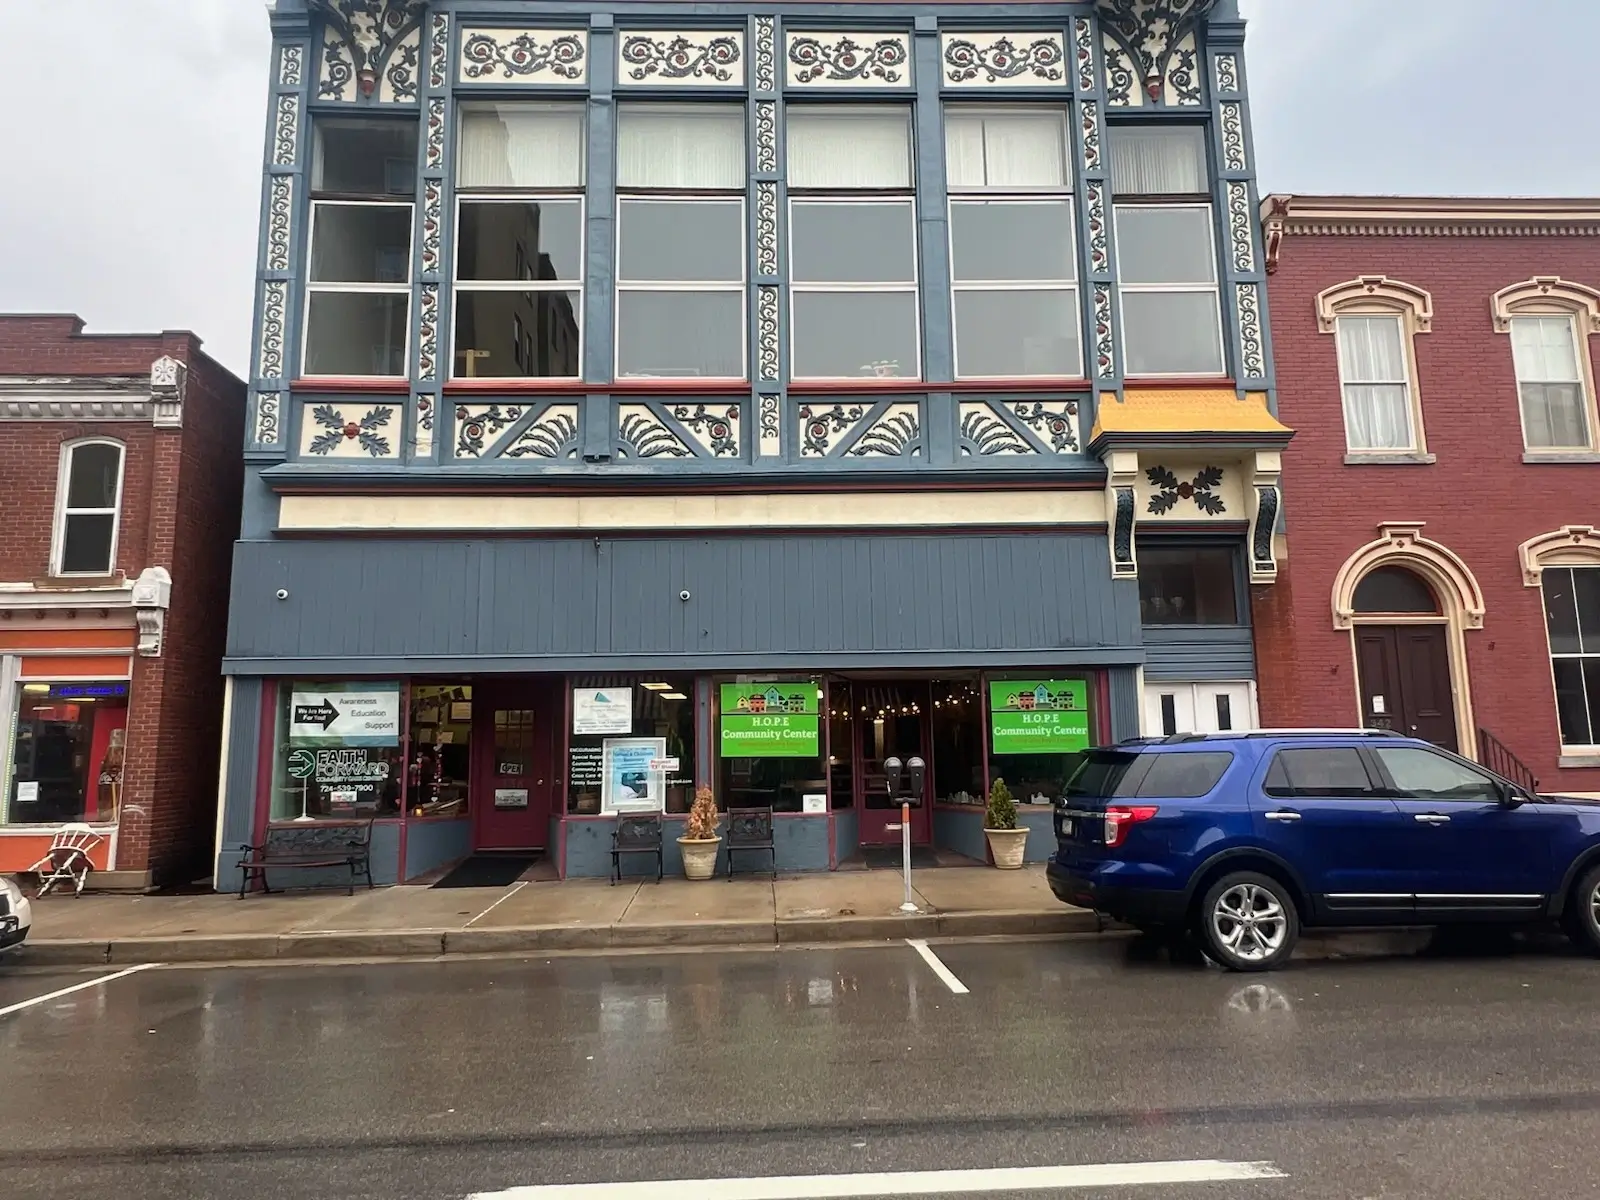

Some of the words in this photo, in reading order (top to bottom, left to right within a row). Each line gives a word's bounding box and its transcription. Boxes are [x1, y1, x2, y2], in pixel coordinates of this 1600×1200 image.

[351, 709, 386, 717] Education
[365, 721, 394, 730] Support
[993, 726, 1052, 737] Community
[1053, 725, 1087, 735] Center
[722, 729, 781, 740] Community
[782, 729, 818, 739] Center
[316, 749, 367, 764] FAITH
[316, 762, 389, 776] FORWARD
[320, 784, 374, 792] 724-539-7900
